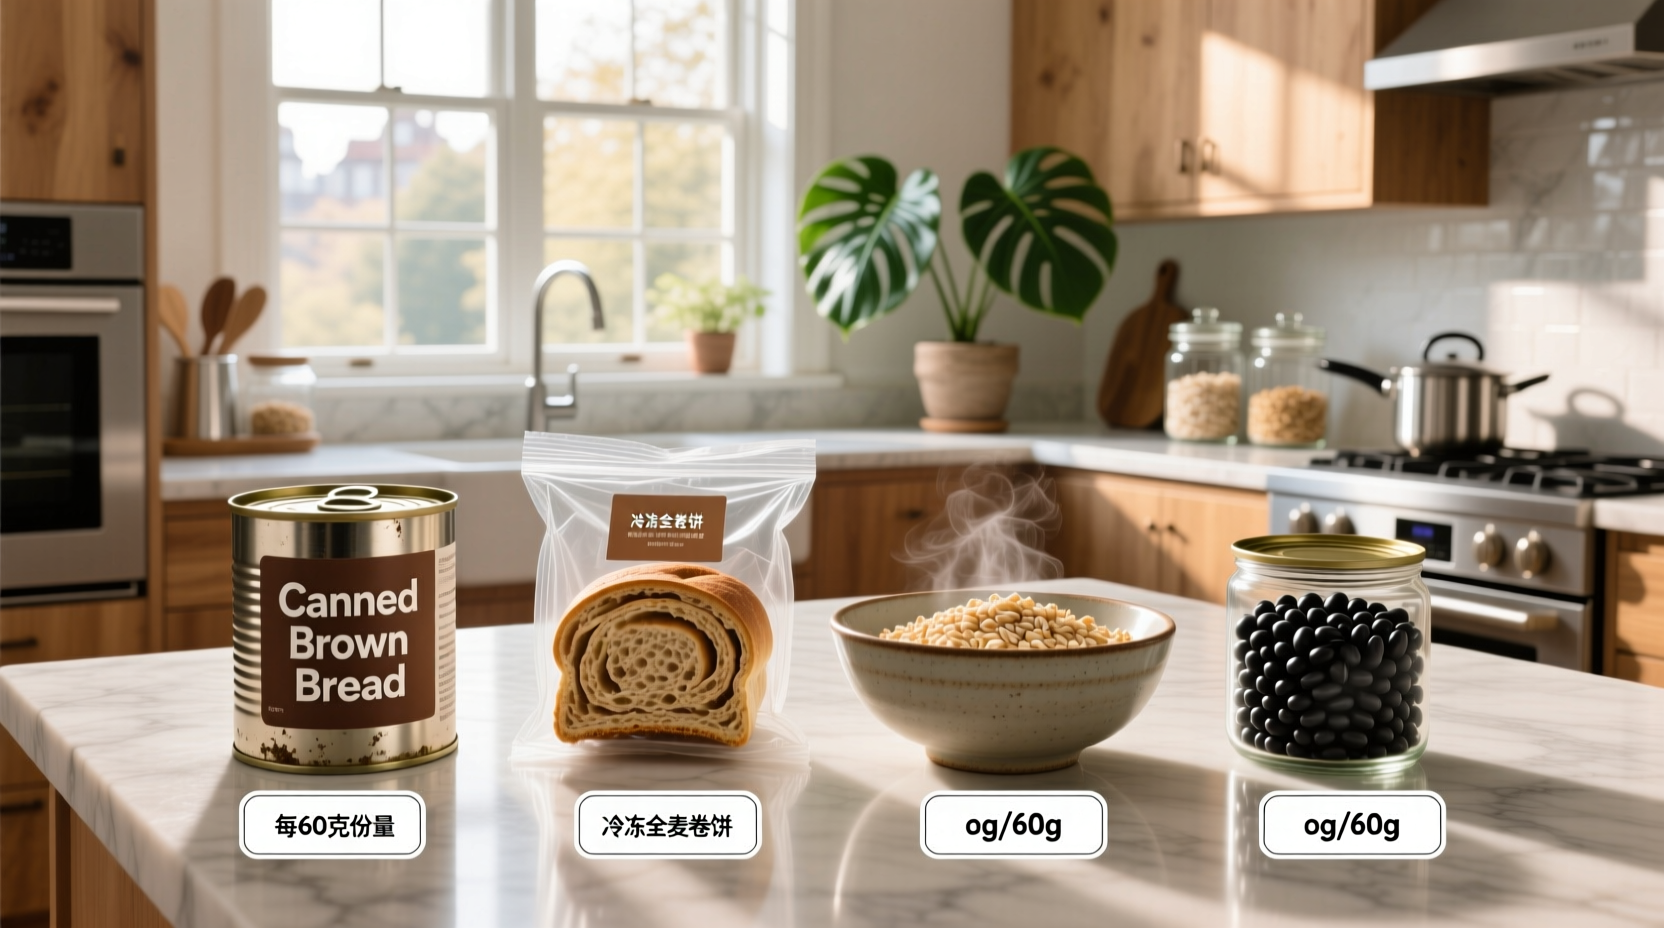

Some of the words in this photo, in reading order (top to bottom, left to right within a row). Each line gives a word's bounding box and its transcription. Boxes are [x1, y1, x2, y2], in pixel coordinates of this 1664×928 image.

[278, 577, 418, 618] Canned
[289, 625, 408, 660] Brown
[295, 663, 406, 702] Bread
